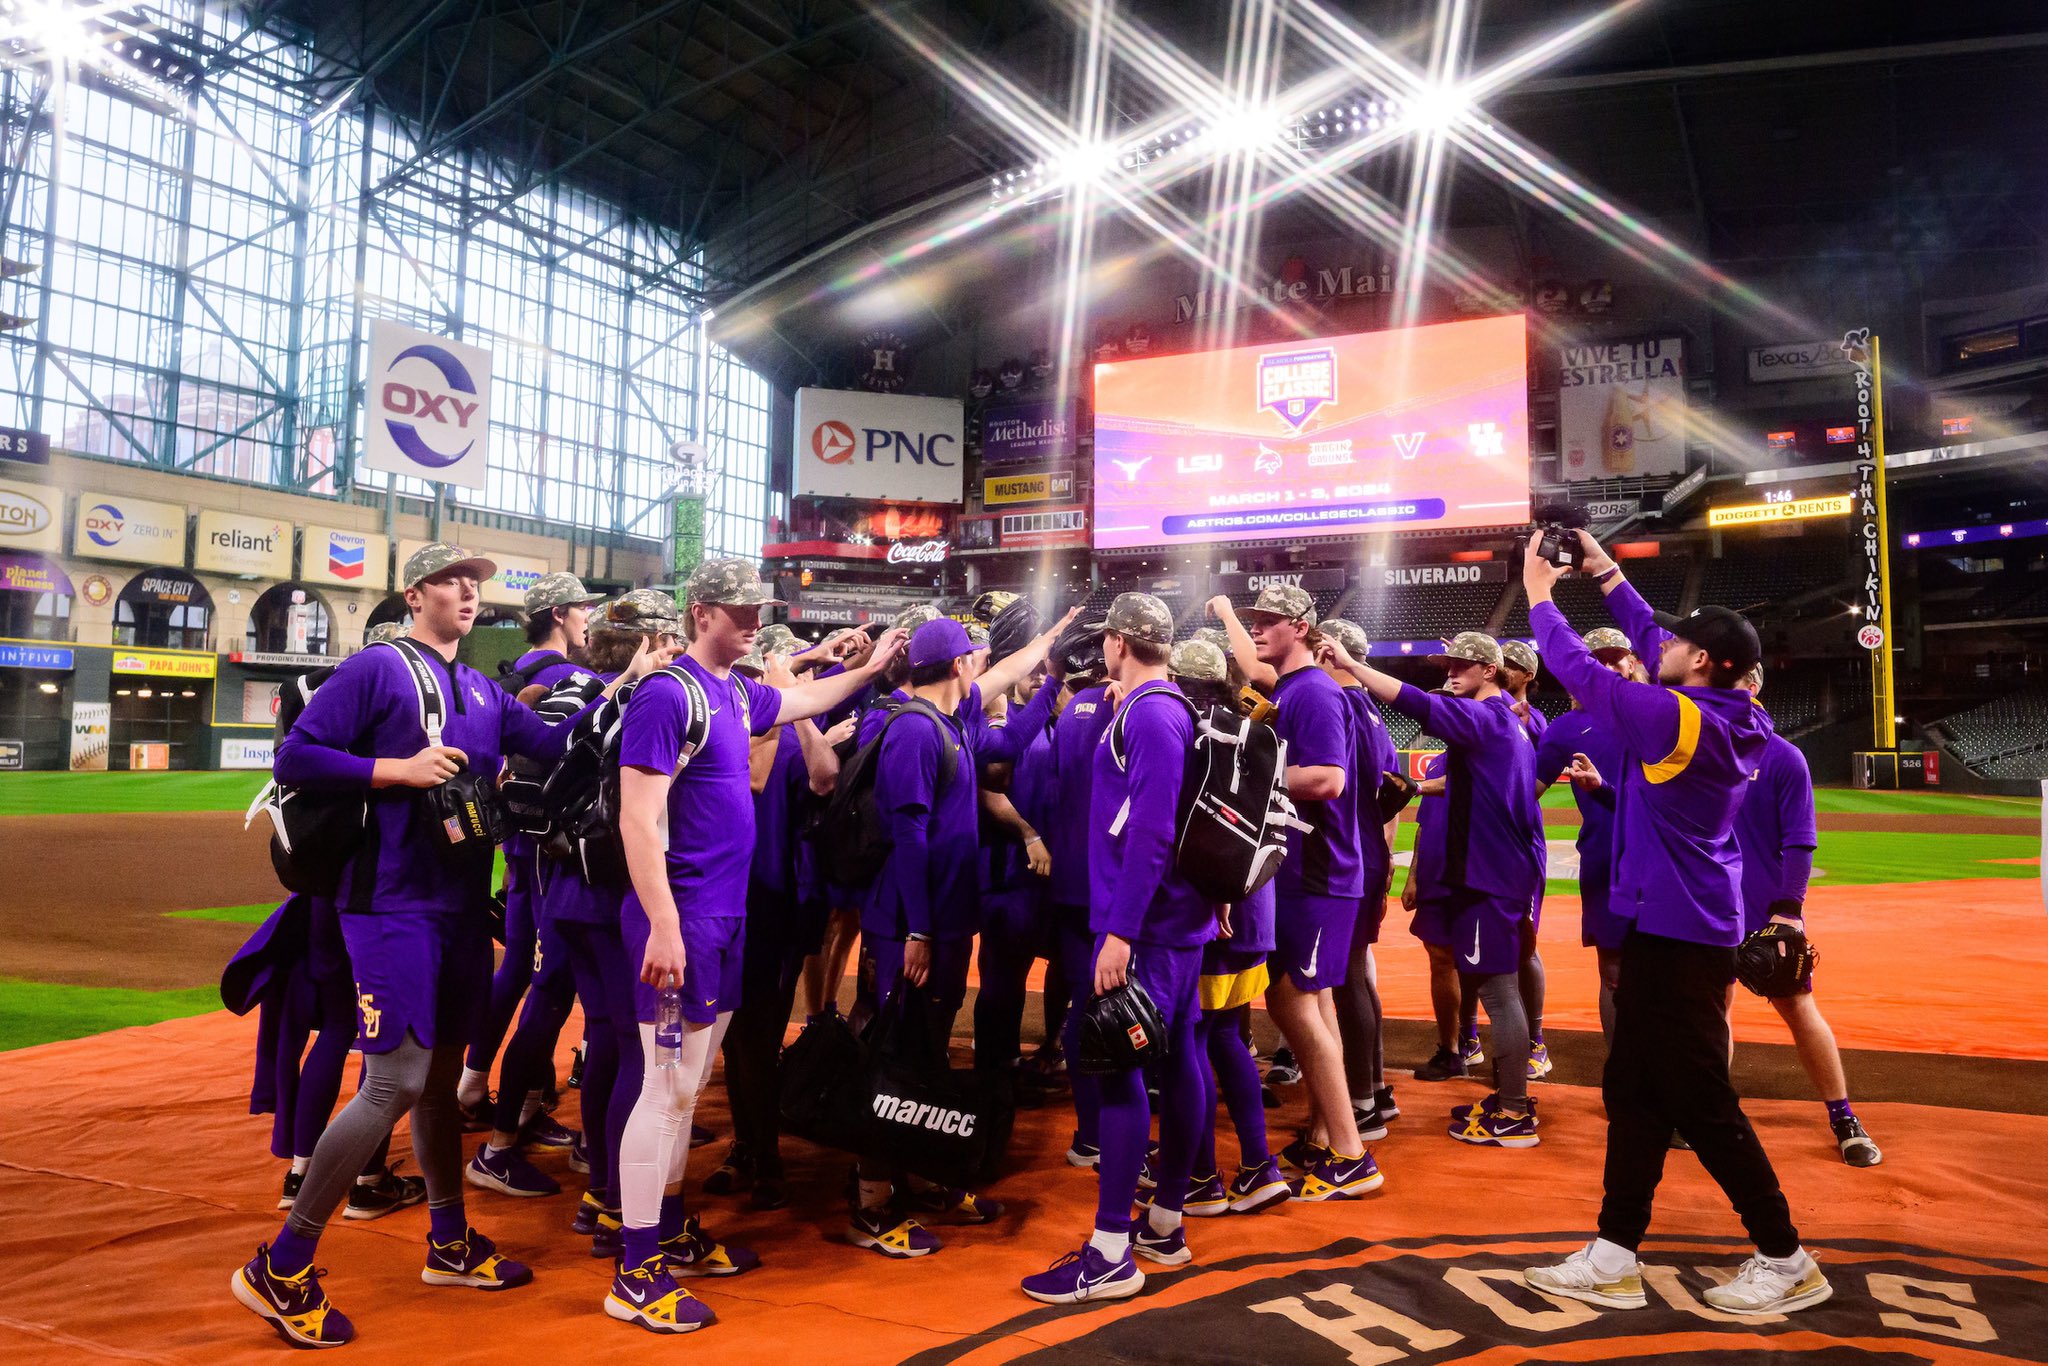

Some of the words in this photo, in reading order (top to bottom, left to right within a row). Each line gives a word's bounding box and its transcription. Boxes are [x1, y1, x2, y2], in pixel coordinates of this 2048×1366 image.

[1564, 344, 1620, 367] VIVE
[1753, 349, 1810, 367] Texas
[1559, 358, 1678, 387] ESTRELLA
[382, 382, 480, 428] OXY
[1854, 371, 1871, 434] ROOT
[989, 419, 1068, 442] Methodist
[861, 428, 956, 466] PNC
[1857, 442, 1871, 458] 4
[1177, 454, 1223, 473] LSU
[995, 481, 1044, 496] MUSTANG
[1051, 478, 1070, 492] CAT
[1209, 493, 1282, 507] MARCH
[1285, 490, 1296, 502] 1
[1334, 482, 1392, 498] 2024
[1765, 489, 1793, 503] 1:46
[1859, 465, 1876, 516] THA
[1715, 508, 1778, 521] DOGGETT
[1799, 501, 1842, 514] RENTS
[86, 518, 124, 532] OXY
[133, 524, 160, 537] ZERO
[210, 529, 273, 553] reliant
[330, 531, 366, 545] Chevron
[6, 566, 48, 578] planet
[800, 560, 846, 570] HORNITOS
[1862, 522, 1880, 621] CHIKIN
[11, 576, 55, 591] fitness
[1248, 573, 1304, 592] CHEVY
[1383, 566, 1482, 586] SILVERADO
[142, 578, 174, 594] SPACE
[173, 582, 195, 596] CITY
[848, 586, 899, 595] HORNITOS
[802, 608, 853, 621] impact
[149, 659, 174, 671] PAPA
[176, 662, 211, 674] JOHN'S
[256, 654, 294, 664] PROVIDING
[296, 657, 321, 666] ENERGY
[75, 725, 107, 735] WM
[1902, 759, 1922, 768] 326
[465, 801, 487, 837] marucci
